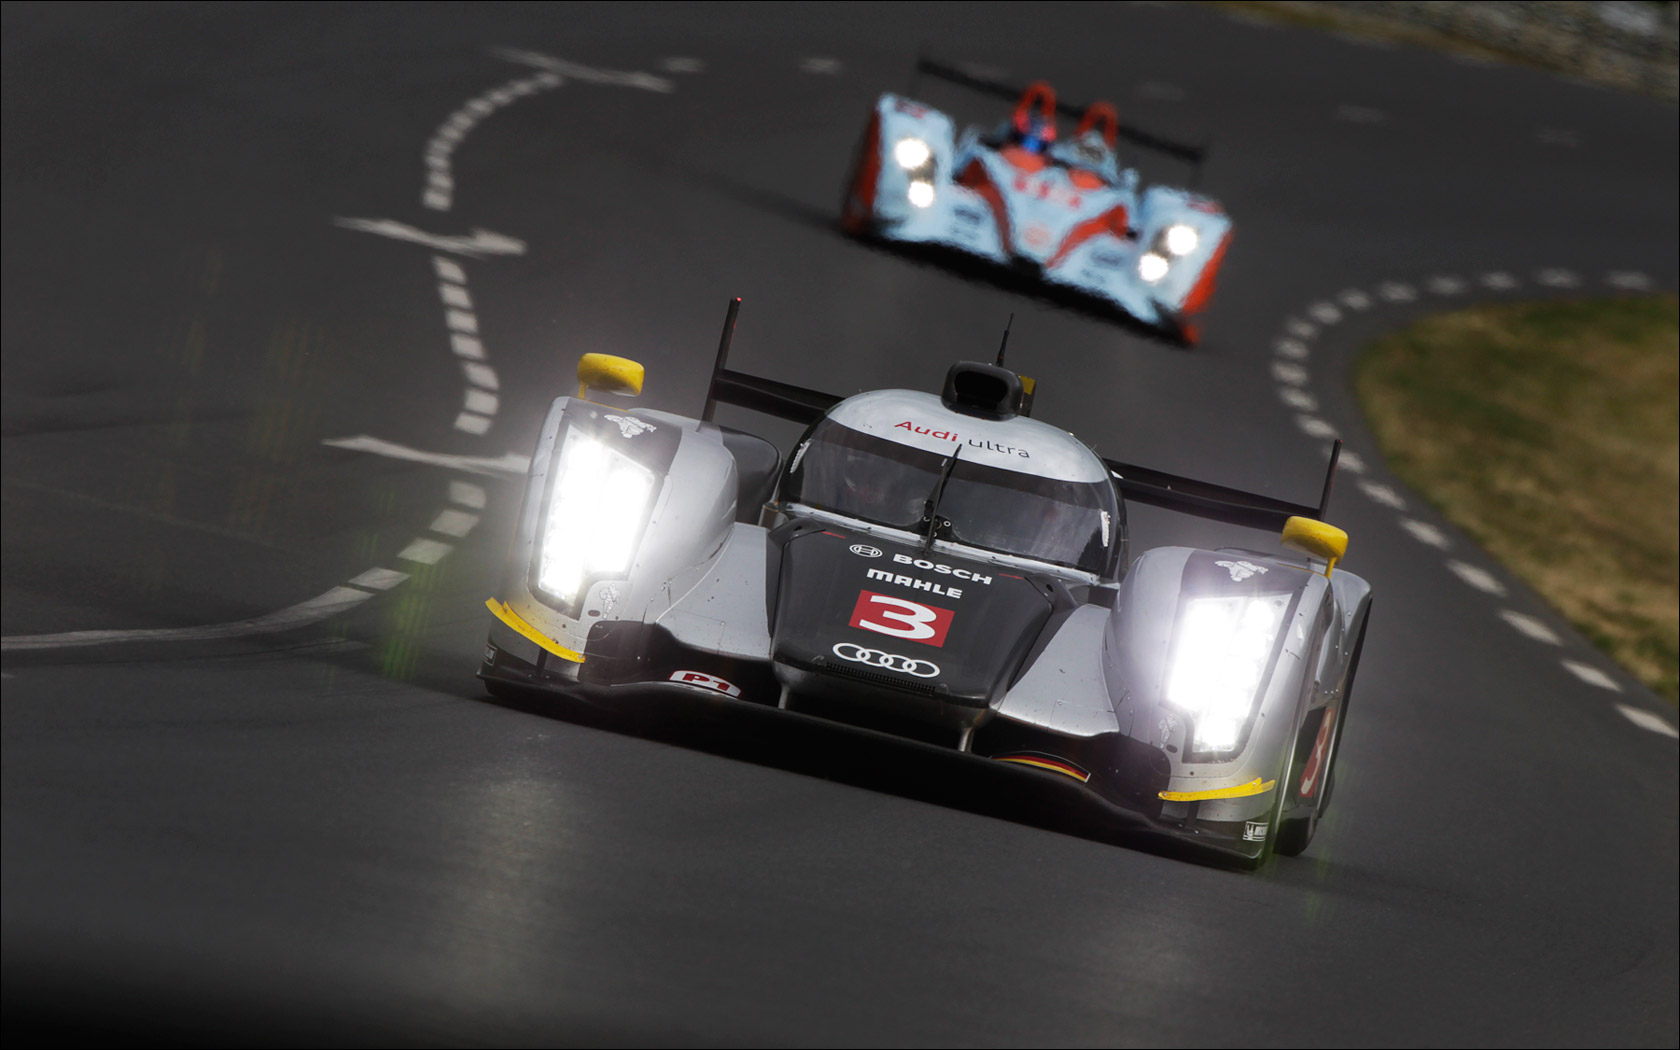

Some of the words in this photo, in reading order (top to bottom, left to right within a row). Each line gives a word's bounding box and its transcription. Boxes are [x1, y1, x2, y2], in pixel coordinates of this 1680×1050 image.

[894, 421, 958, 442] Audi
[968, 439, 1030, 458] ultra
[866, 568, 963, 599] MAHLE
[892, 553, 993, 585] BOSCH
[859, 595, 937, 639] 3
[682, 673, 730, 691] P1
[1301, 711, 1331, 794] 3
